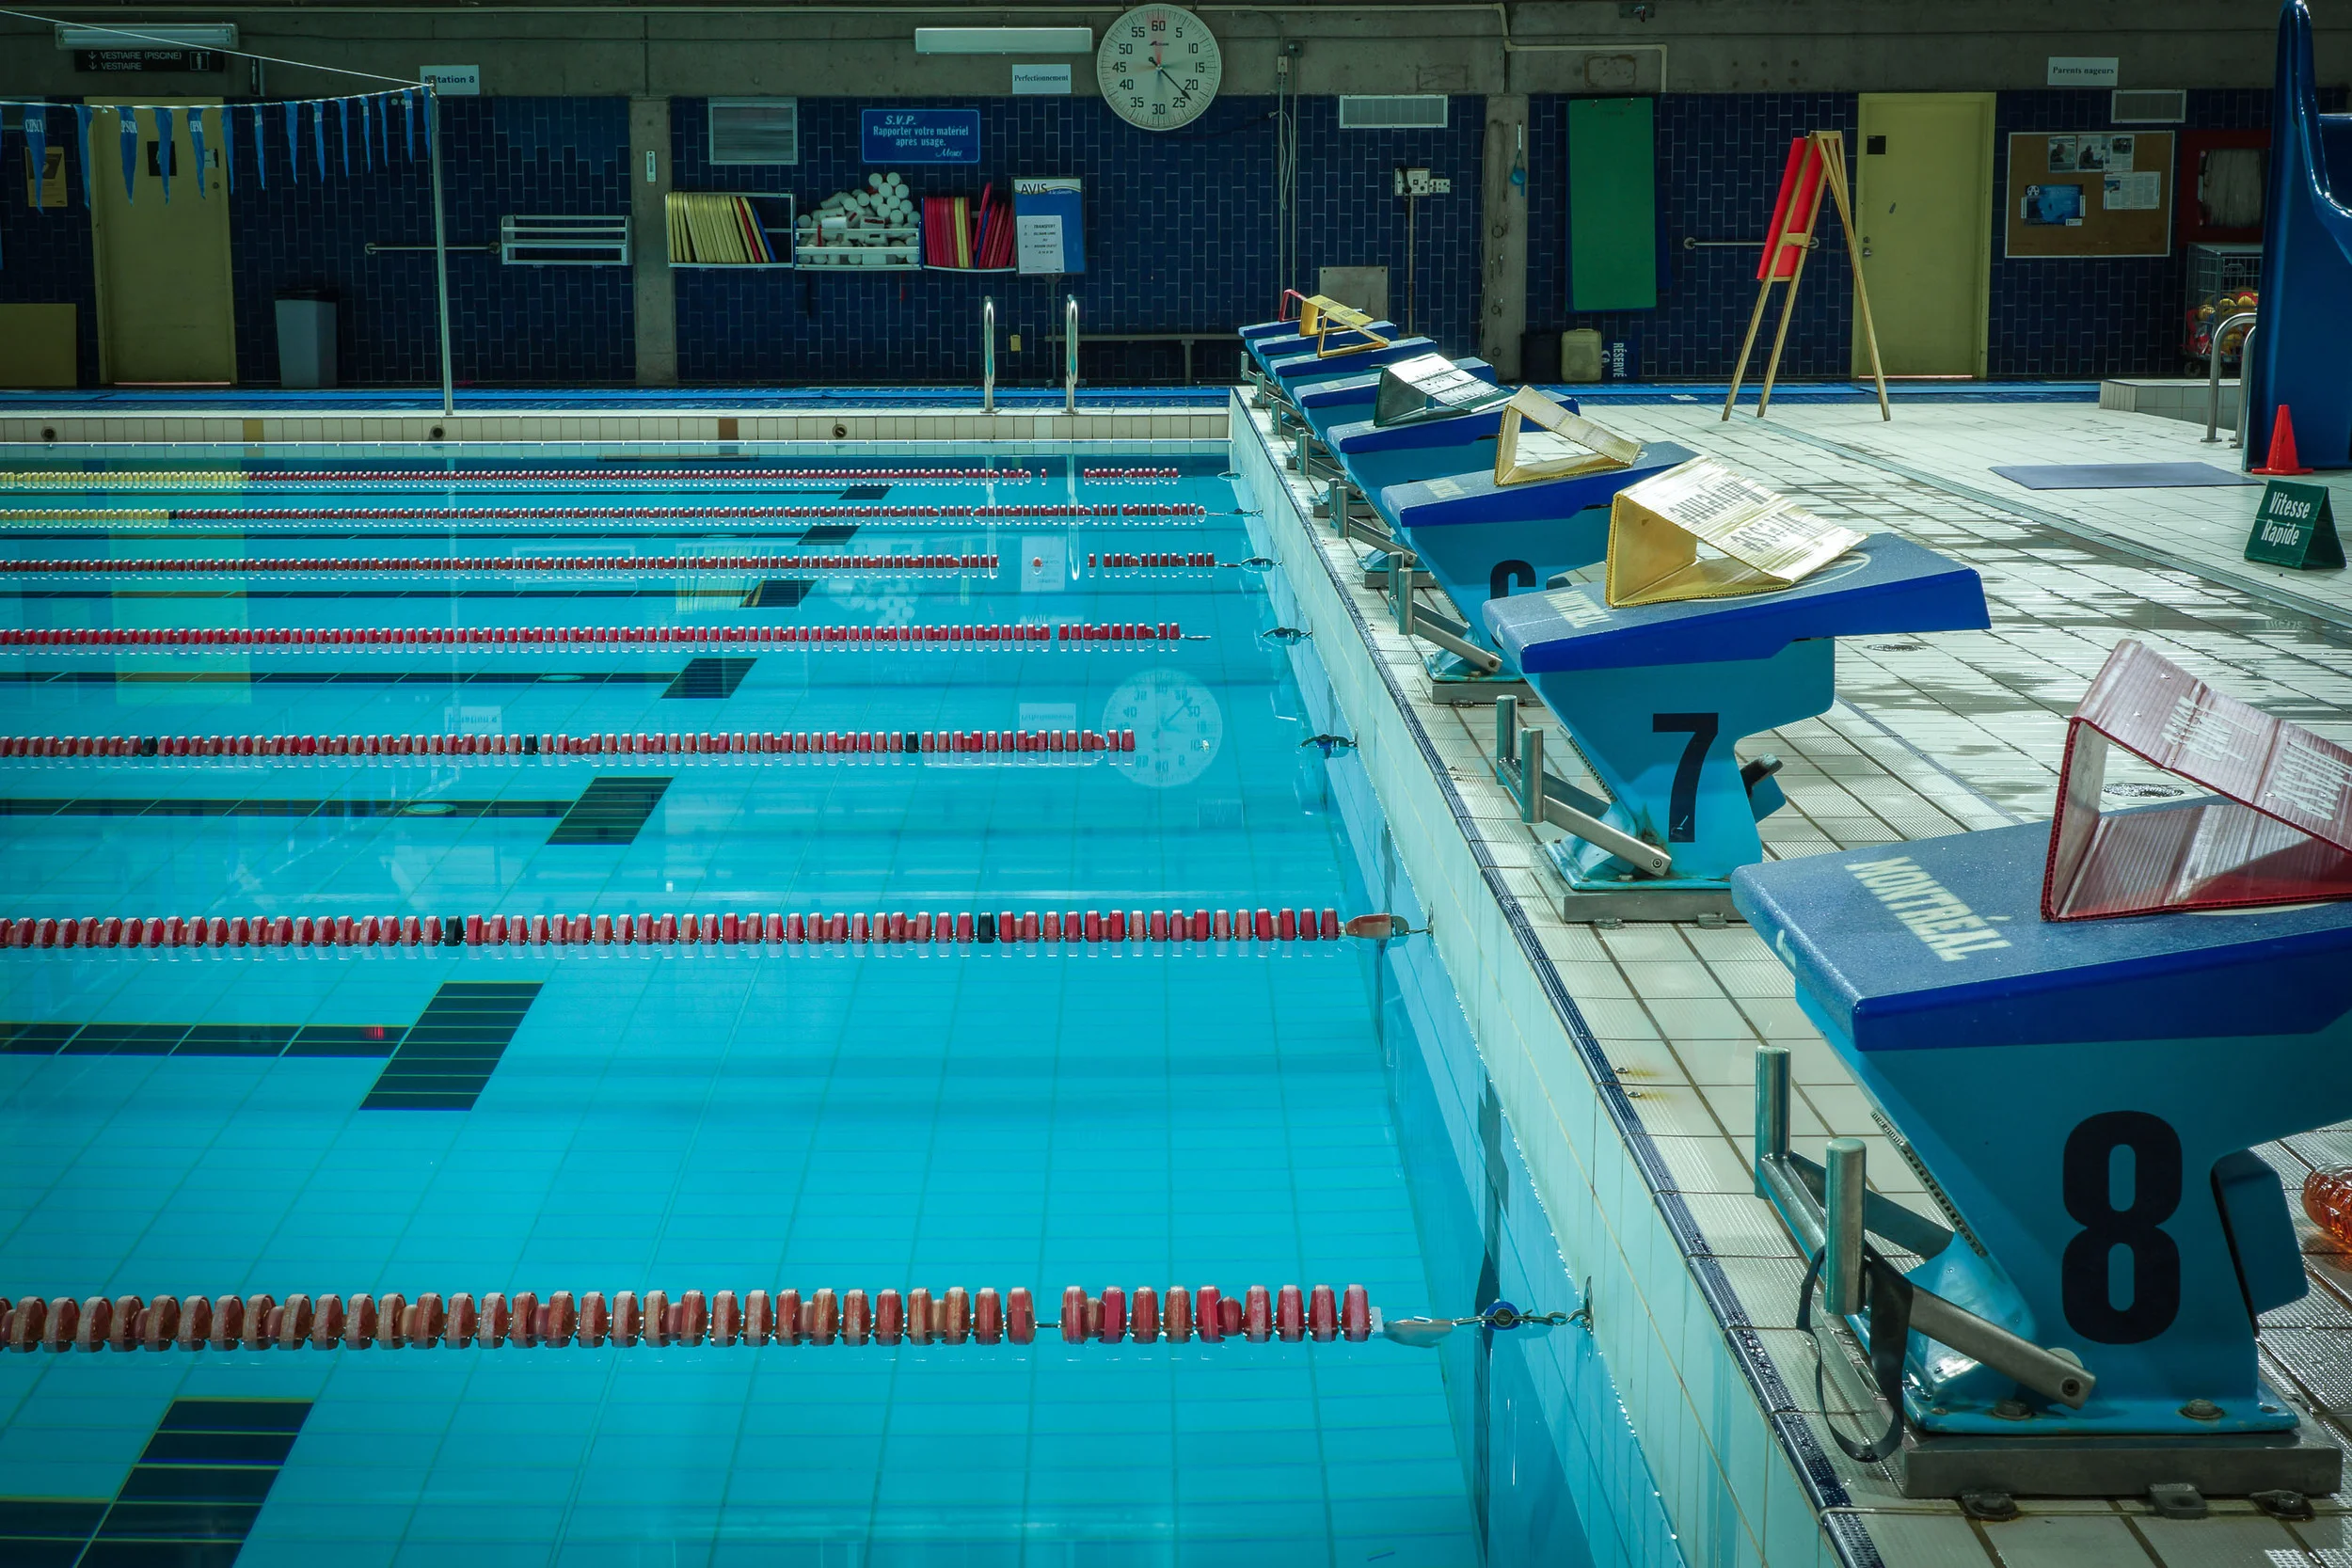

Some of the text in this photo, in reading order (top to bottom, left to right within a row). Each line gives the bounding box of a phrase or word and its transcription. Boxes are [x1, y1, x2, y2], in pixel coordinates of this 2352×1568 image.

[1151, 20, 1166, 31] 60
[1131, 26, 1145, 38] 55
[1175, 27, 1183, 39] 5
[1119, 43, 1133, 55] 50
[1188, 42, 1199, 54] 10
[144, 52, 182, 60] (PISCINE)
[101, 62, 142, 71] VESTIAIRE
[1112, 61, 1127, 72] 45
[1195, 62, 1205, 73] 15
[2053, 66, 2115, 76] Parents nageurs
[424, 75, 475, 84] Ntation 8
[1119, 79, 1134, 90] 40
[1184, 79, 1199, 90] 20
[1130, 97, 1144, 108] 35
[1172, 97, 1185, 108] 25
[1152, 103, 1166, 115] 30
[884, 115, 916, 125] S.V.P.
[873, 125, 969, 137] Rapporter votre matériel
[921, 138, 946, 148] usage.
[1021, 183, 1047, 195] AVIS
[1613, 342, 1628, 378] RÉSERVÉ
[2268, 491, 2311, 519] Vitesse
[2261, 518, 2300, 547] Rapide
[1653, 712, 1719, 843] 7
[1844, 856, 2012, 962] MONTRÉAL
[2062, 1110, 2183, 1345] 8
